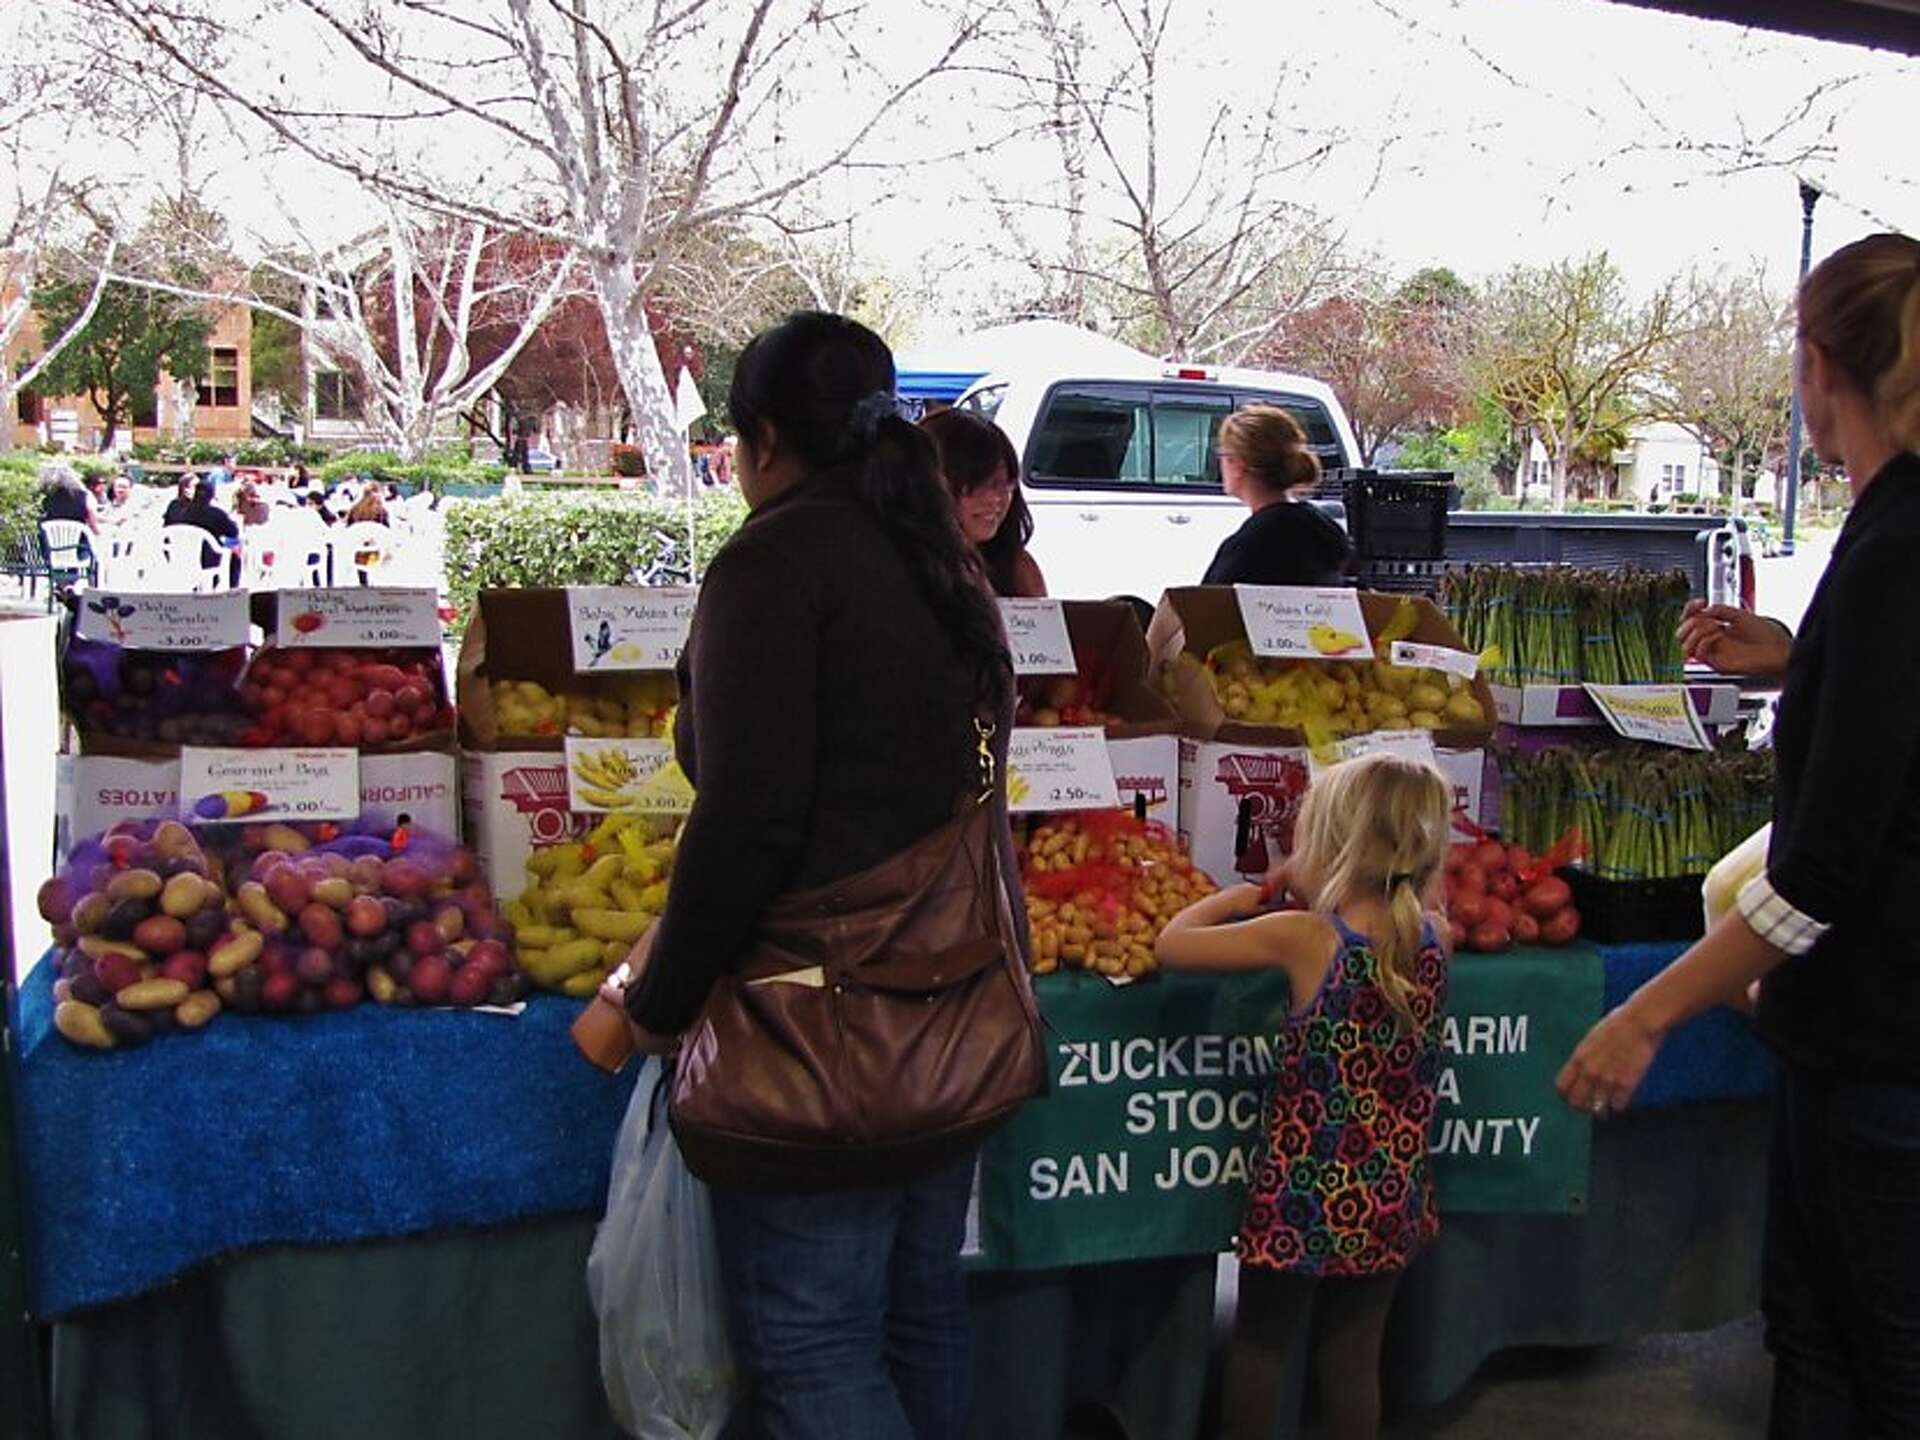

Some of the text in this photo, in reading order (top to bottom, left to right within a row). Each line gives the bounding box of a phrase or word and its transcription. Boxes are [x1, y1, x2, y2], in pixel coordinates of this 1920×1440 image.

[1440, 1015, 1529, 1055] ARM
[1126, 1089, 1266, 1135] STOC
[1029, 1150, 1129, 1201] SAN
[1154, 1143, 1258, 1191] JOA
